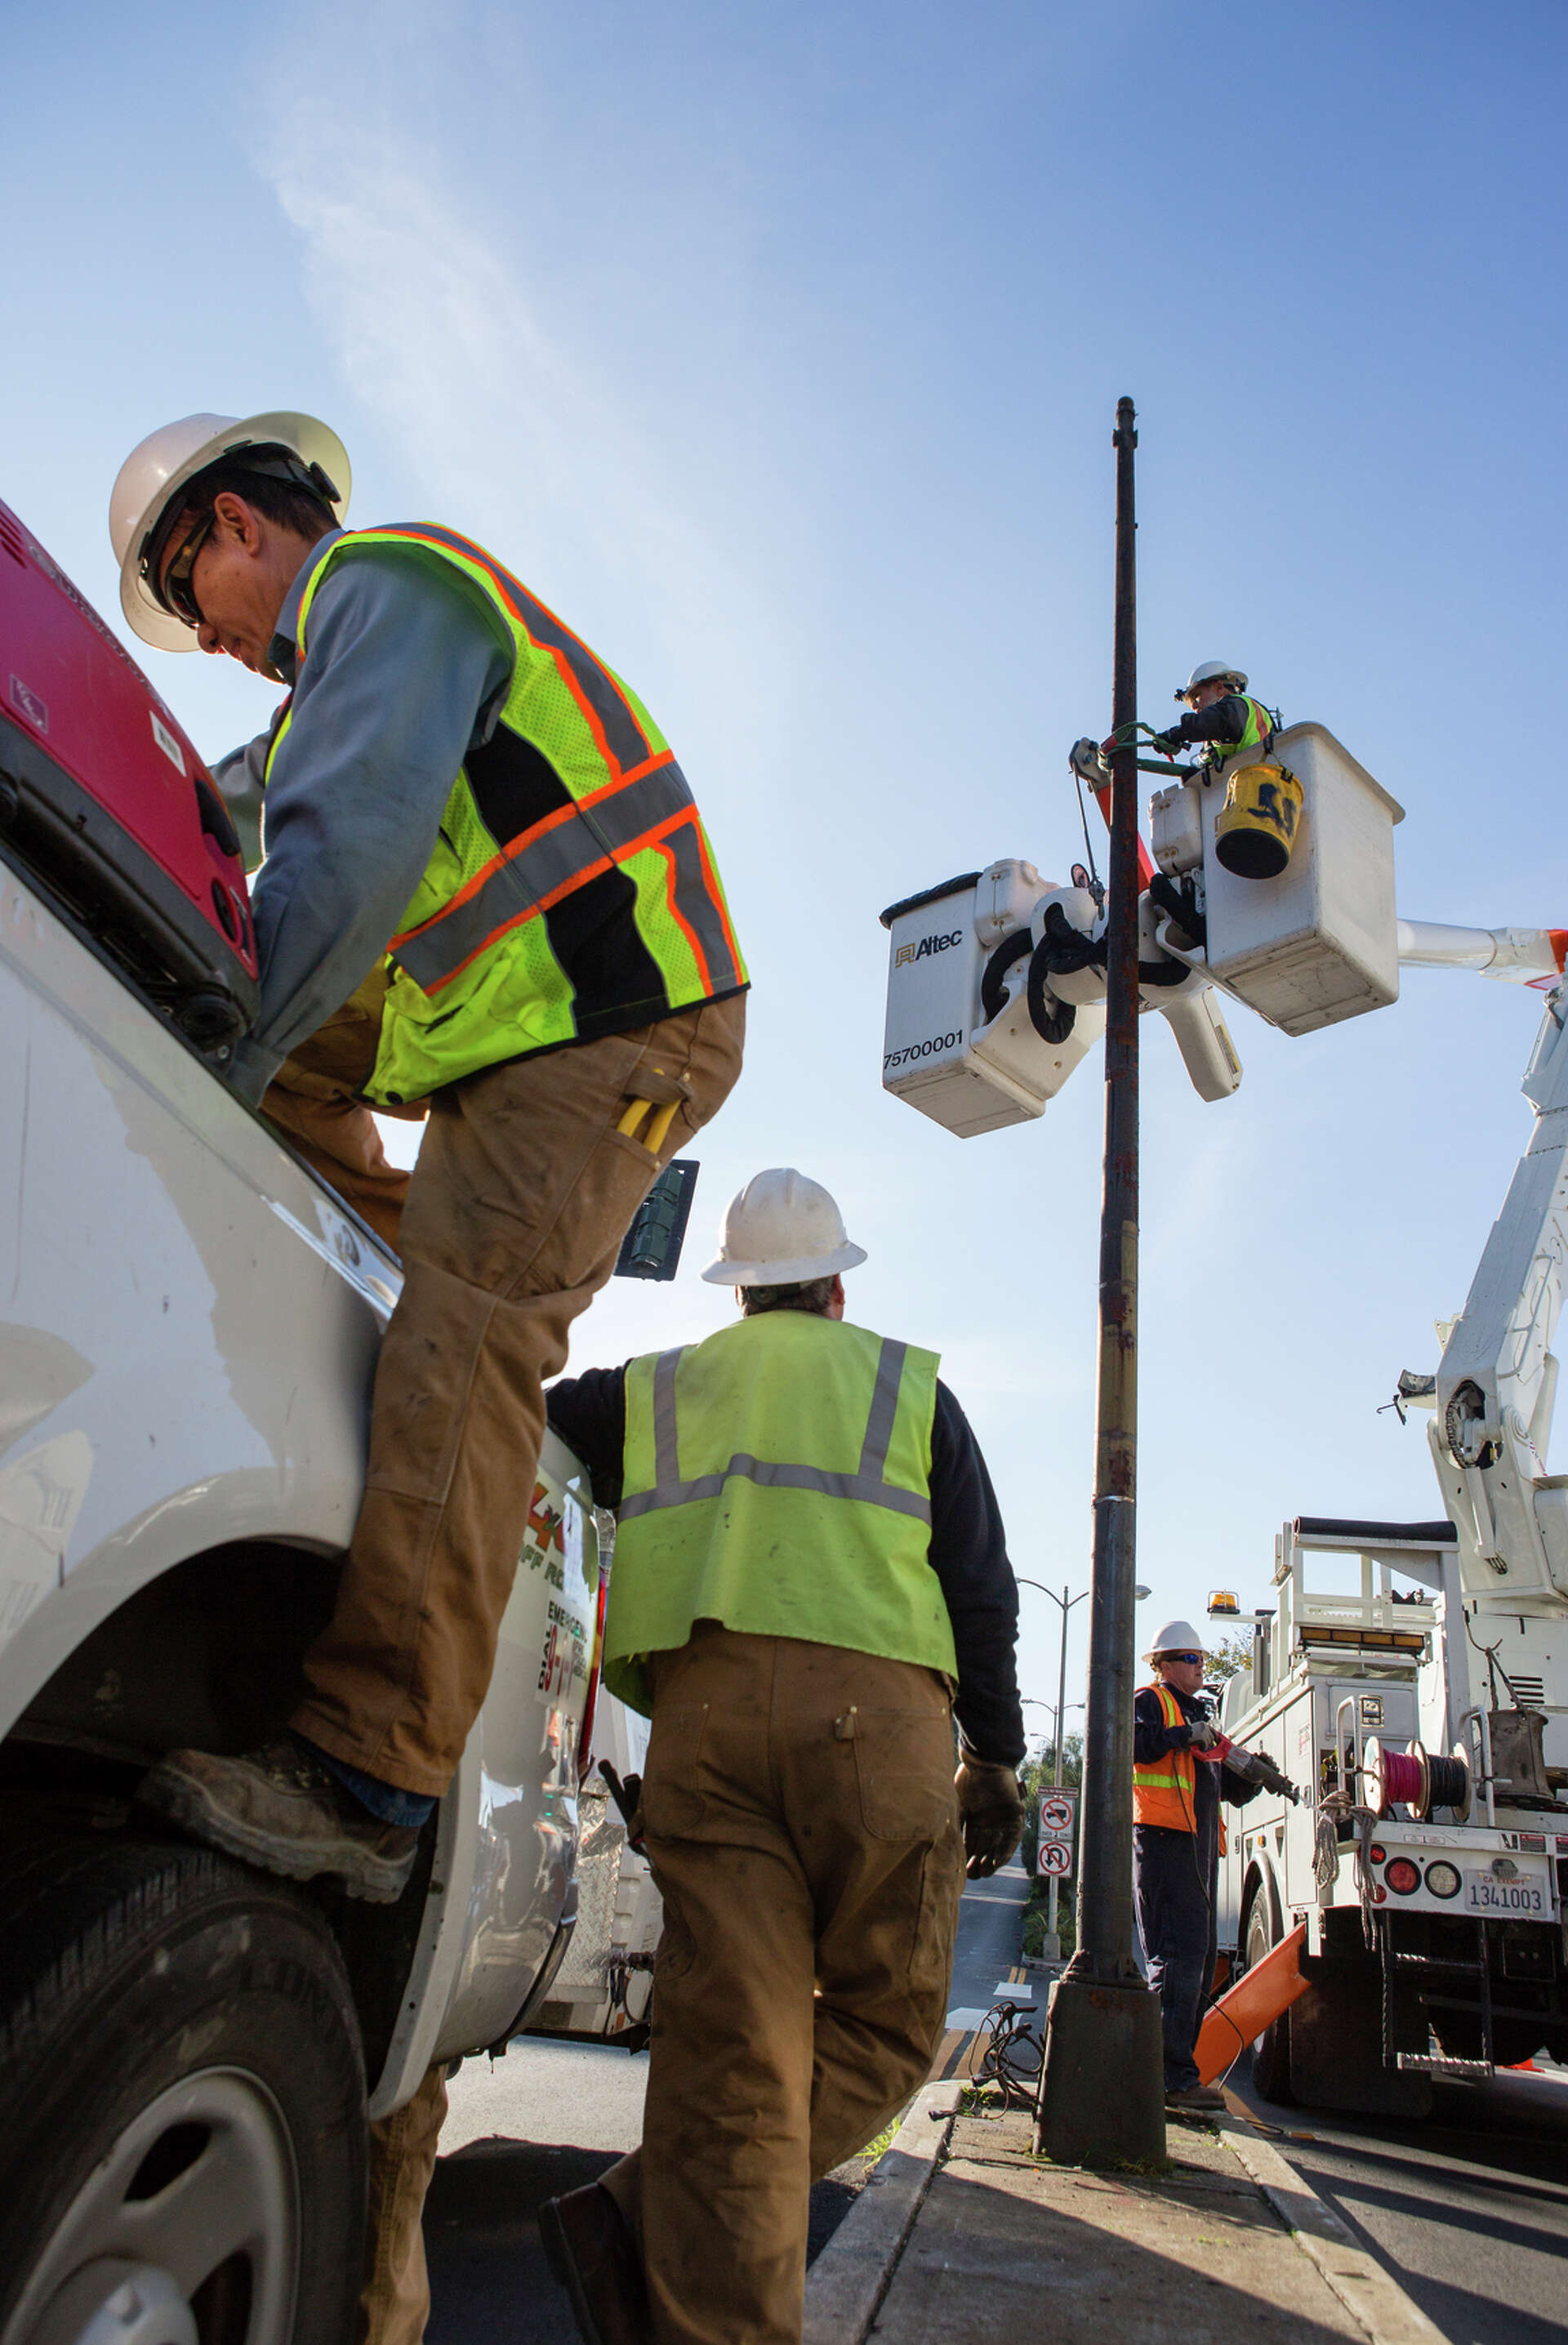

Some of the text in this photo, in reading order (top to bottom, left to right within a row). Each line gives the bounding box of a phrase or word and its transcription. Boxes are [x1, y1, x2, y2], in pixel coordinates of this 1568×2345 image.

[915, 930, 963, 961] Altec
[884, 1030, 963, 1069] 75700001
[519, 1544, 545, 1570] FF
[1470, 1884, 1541, 1910] 1341003
